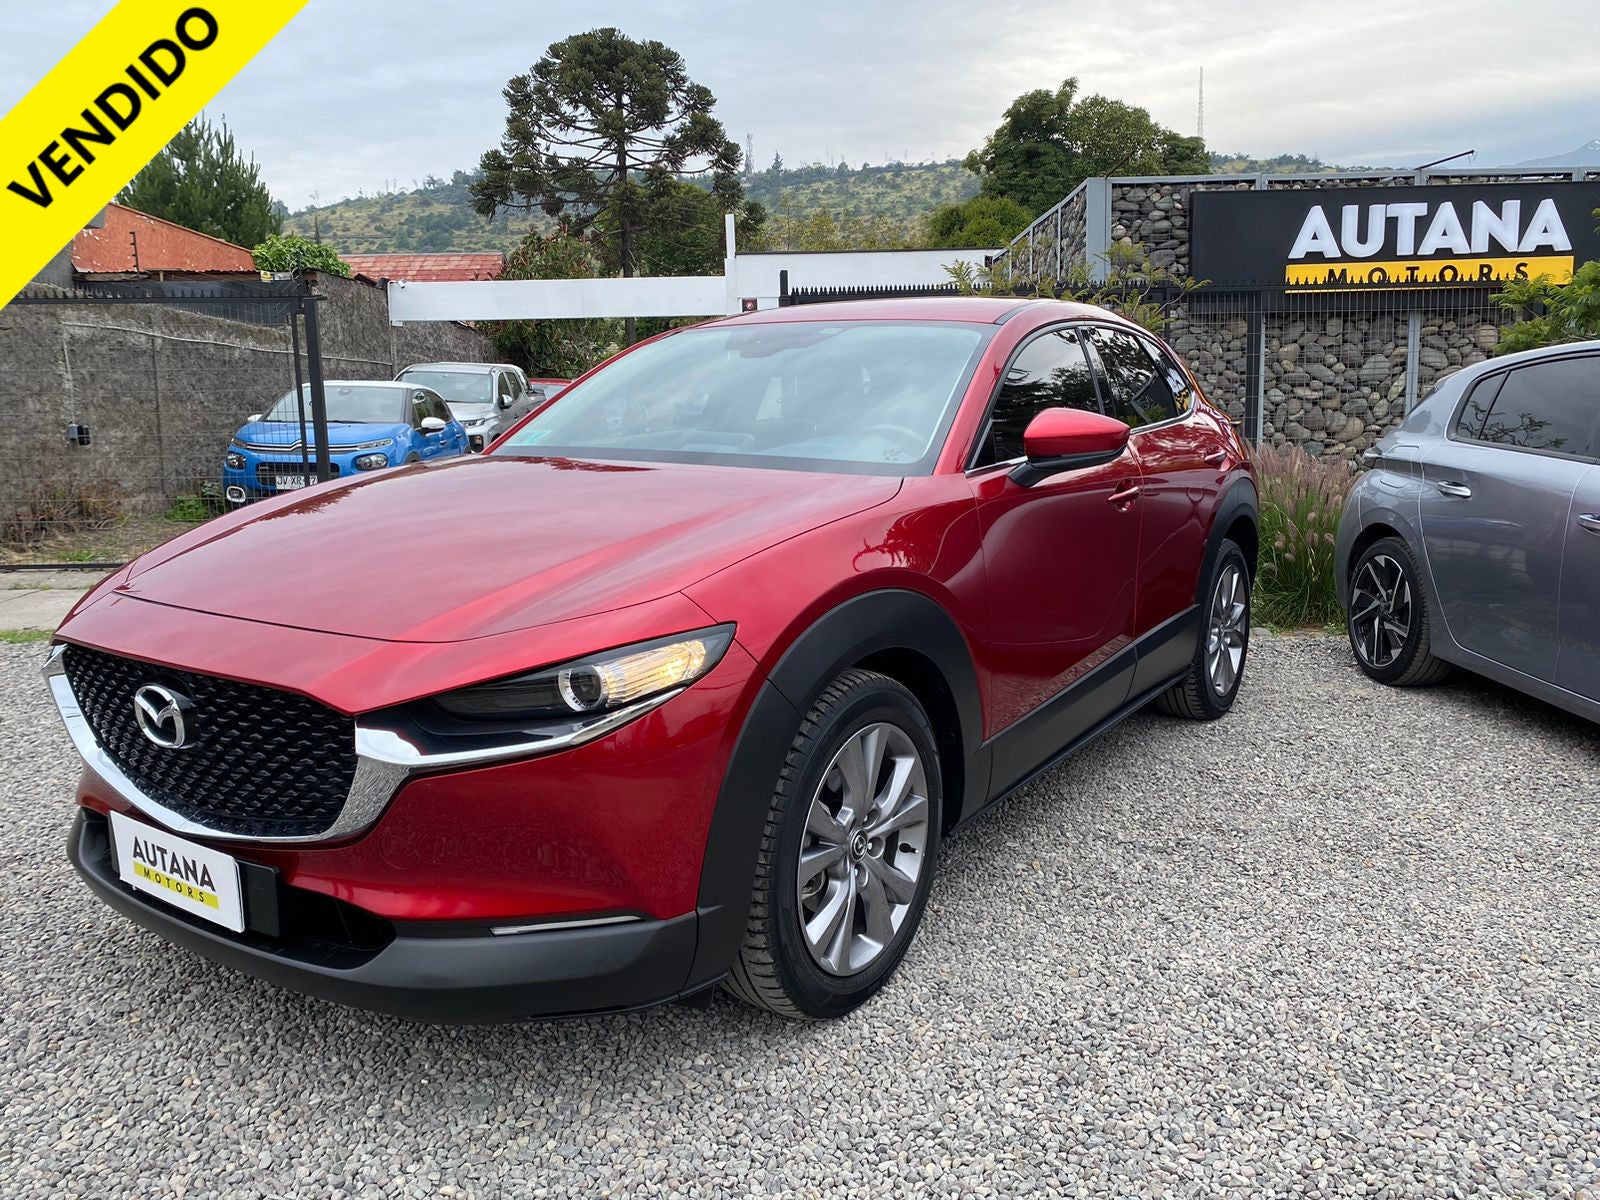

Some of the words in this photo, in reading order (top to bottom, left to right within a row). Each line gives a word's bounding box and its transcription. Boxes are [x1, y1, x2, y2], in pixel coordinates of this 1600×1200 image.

[1288, 198, 1573, 259] AUTANA
[1327, 262, 1529, 285] MOTORS
[132, 836, 216, 892] AUTANA
[143, 867, 204, 903] MOTORS
